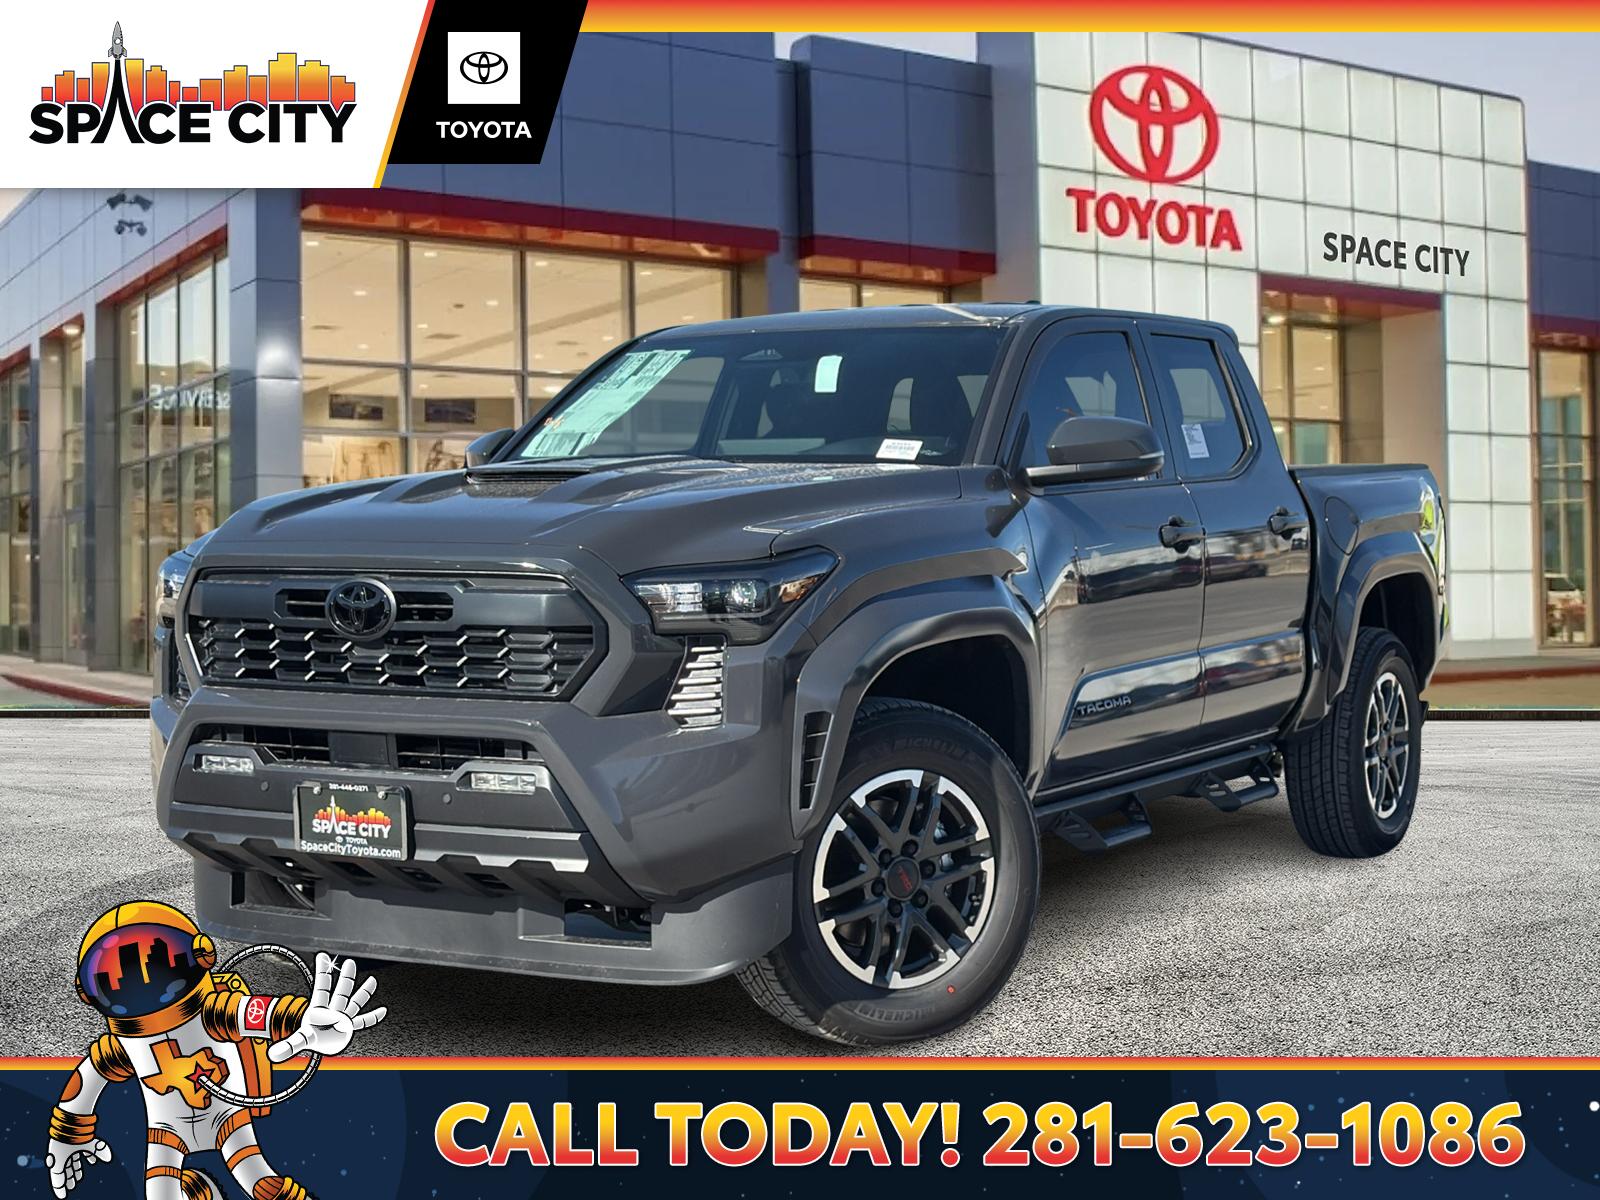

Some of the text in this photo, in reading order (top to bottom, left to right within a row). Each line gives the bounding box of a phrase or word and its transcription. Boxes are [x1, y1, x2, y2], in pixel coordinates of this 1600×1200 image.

[1066, 187, 1243, 251] TOYOTA
[1322, 231, 1470, 277] SPACE CITY
[1076, 695, 1132, 715] TACOMA
[312, 815, 391, 839] SPACE CITY
[300, 840, 401, 858] SpaceCityToyota.com
[345, 836, 368, 846] TOYOTA
